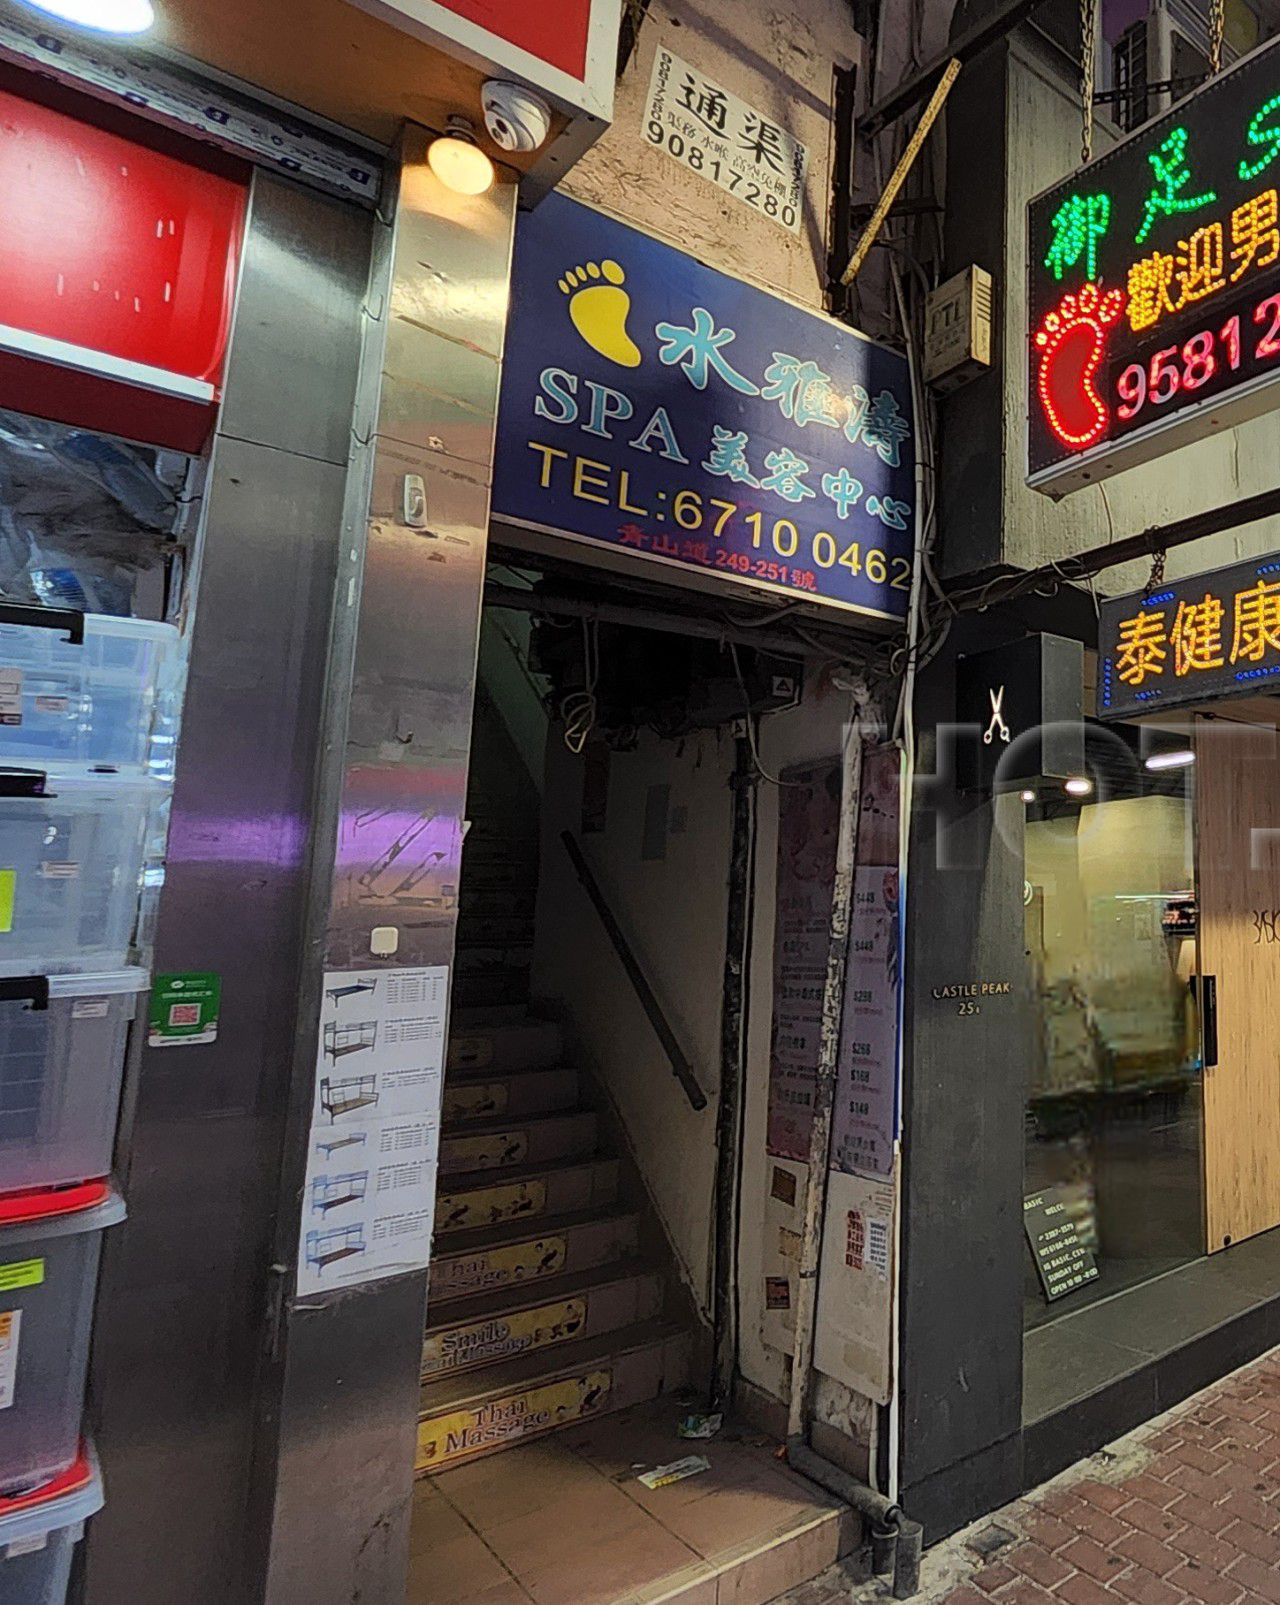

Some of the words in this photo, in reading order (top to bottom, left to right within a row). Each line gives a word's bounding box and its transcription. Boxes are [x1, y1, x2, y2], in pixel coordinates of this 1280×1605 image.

[646, 120, 796, 226] 90817280
[675, 72, 786, 176] 通渠
[534, 367, 690, 465] SPA
[701, 425, 911, 530] 美容中心
[528, 441, 798, 557] TEL:6710
[813, 532, 911, 591] 0462
[443, 1409, 551, 1455] Massage
[473, 1396, 527, 1427] Thai
